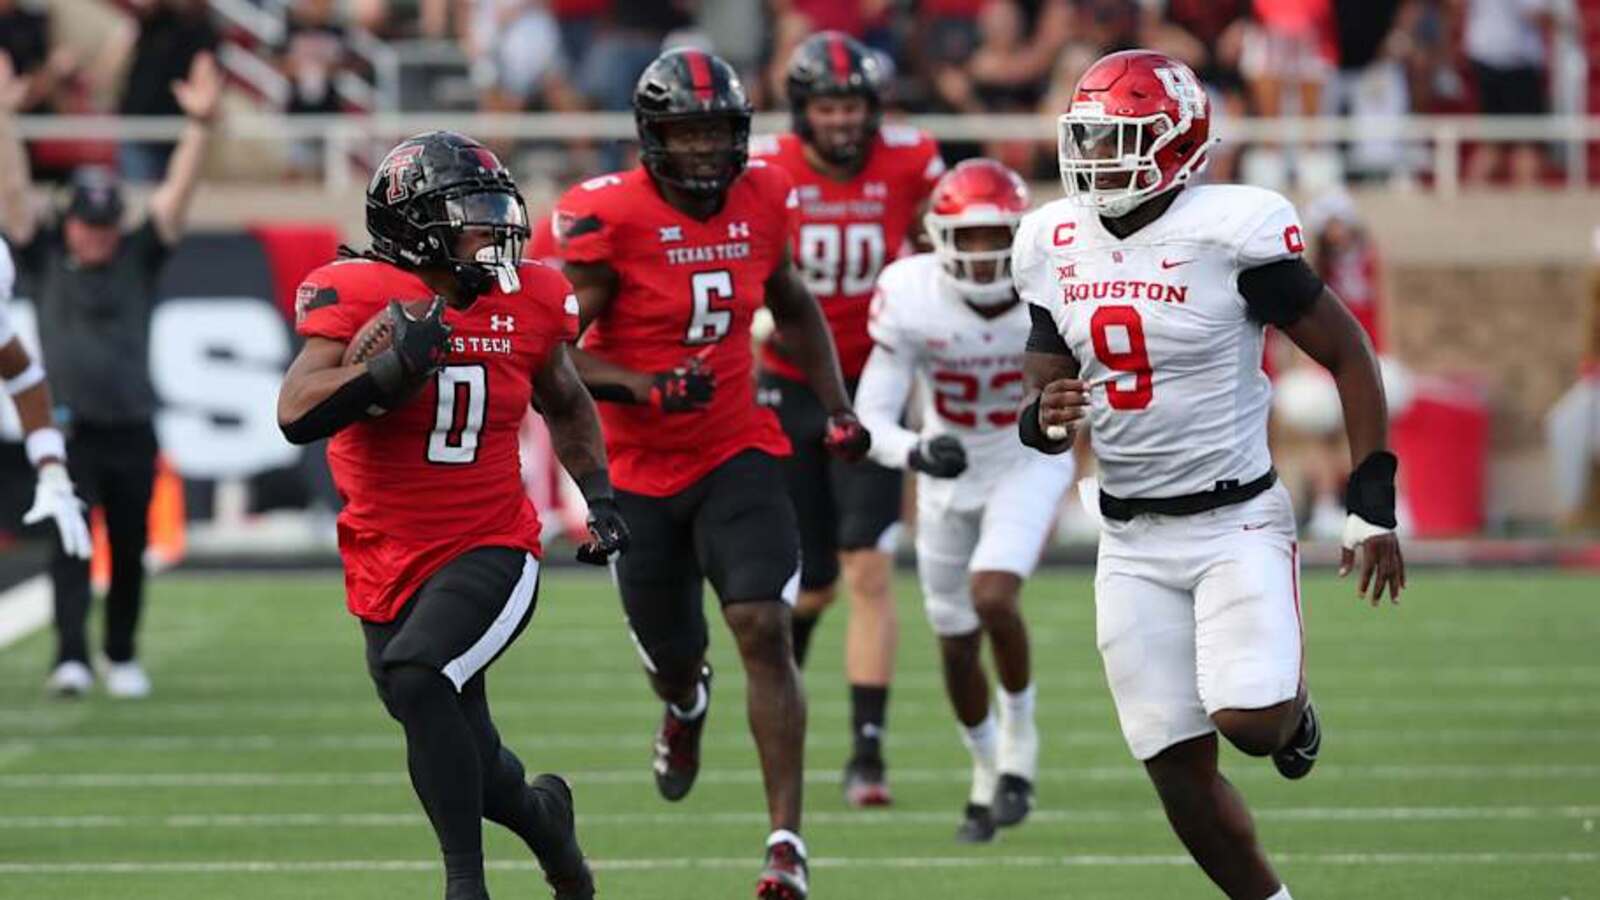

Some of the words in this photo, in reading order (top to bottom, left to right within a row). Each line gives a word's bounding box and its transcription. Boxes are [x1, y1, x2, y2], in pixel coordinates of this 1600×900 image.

[1053, 222, 1076, 246] C
[667, 246, 714, 264] TEXAS
[716, 242, 750, 260] TECH
[1063, 280, 1188, 305] HOUSTON
[686, 269, 733, 345] 6
[468, 337, 512, 354] TECH
[1090, 305, 1154, 411] 9
[427, 362, 487, 465] 0
